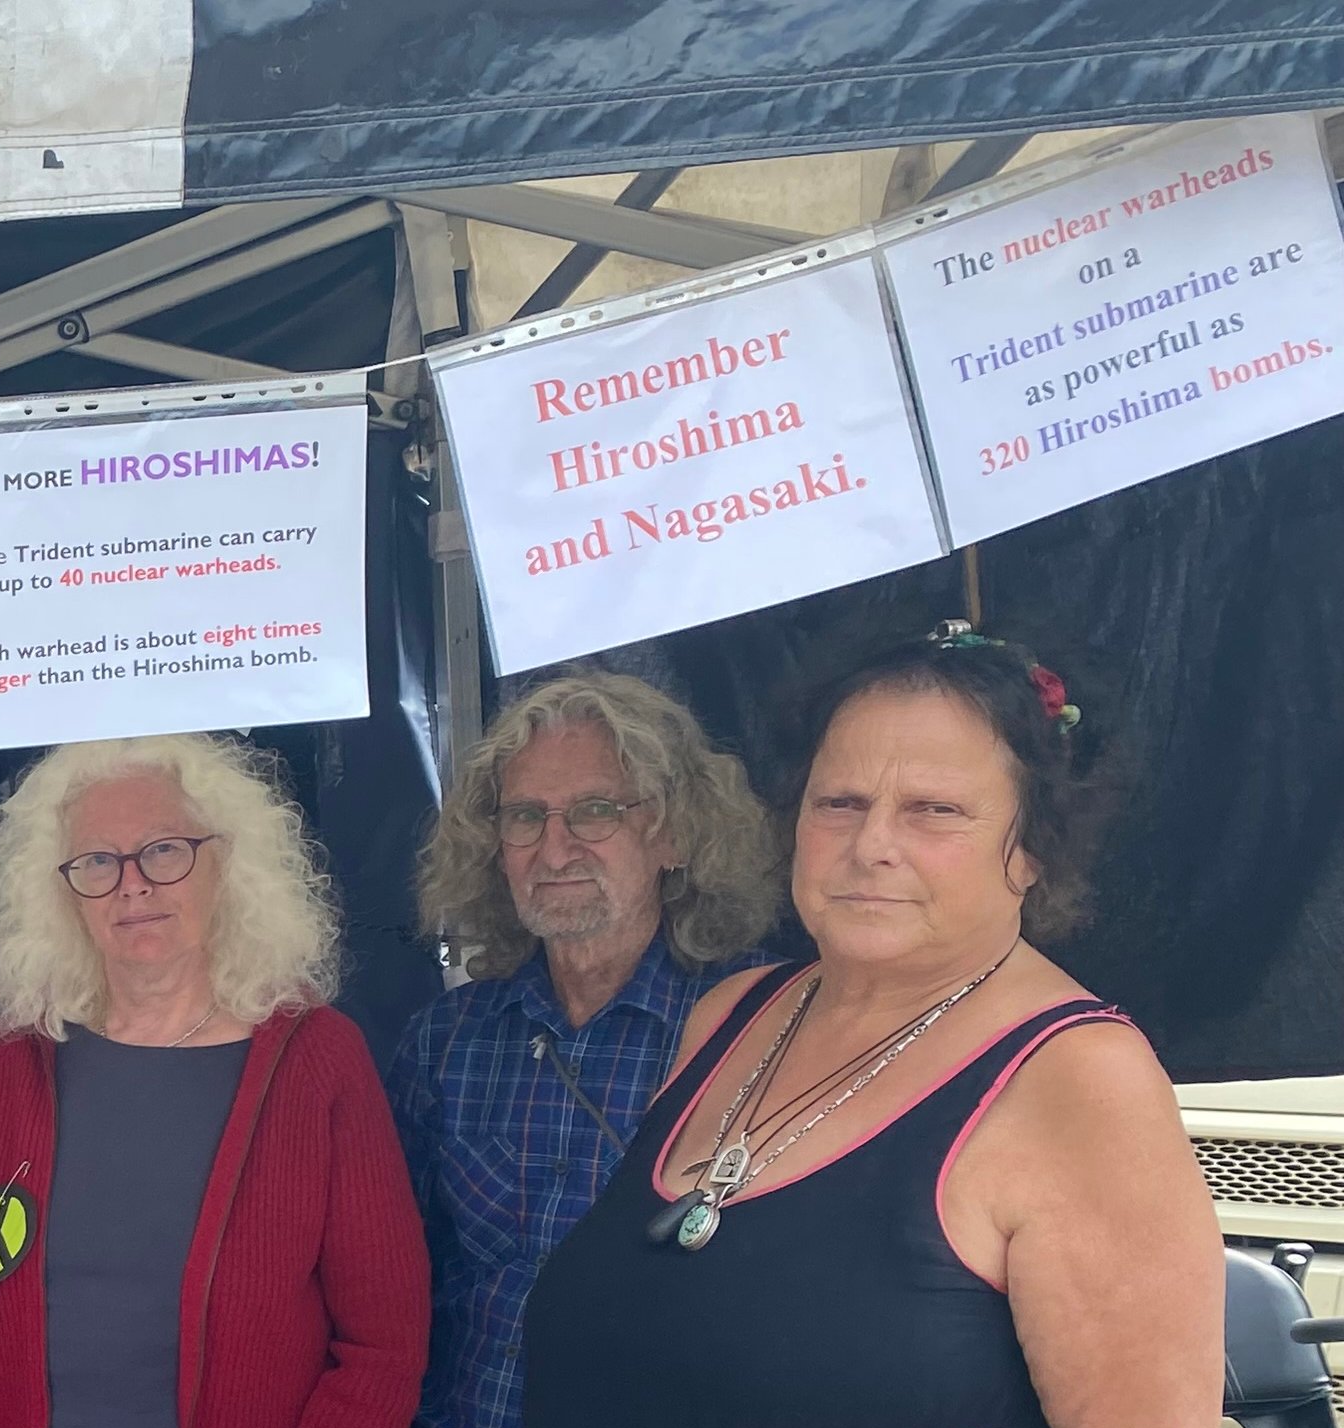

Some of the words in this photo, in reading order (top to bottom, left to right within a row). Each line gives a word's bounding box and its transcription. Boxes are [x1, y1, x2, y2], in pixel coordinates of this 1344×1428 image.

[933, 251, 995, 287] The
[1003, 207, 1112, 264] nuclear
[1121, 147, 1274, 218] warheads
[1078, 257, 1115, 285] on
[1124, 246, 1142, 267] a
[950, 323, 1066, 384] Trident
[1072, 264, 1240, 341] submarine
[1248, 242, 1304, 277] are
[529, 328, 790, 424] Remember
[1024, 380, 1056, 407] as
[1063, 319, 1203, 402] powerful
[1210, 312, 1245, 340] as
[545, 402, 806, 493] Hiroshima
[979, 435, 1030, 476] 320
[1036, 372, 1203, 455] Hiroshima
[1209, 337, 1334, 392] bombs.
[3, 468, 73, 492] MORE
[81, 439, 320, 486] HIROSHIMAS!
[13, 541, 95, 563] Trident
[100, 531, 212, 557] submarine
[219, 531, 255, 547] can
[262, 526, 318, 545] carry
[525, 518, 613, 576] and
[620, 453, 866, 552] Nagasaki.
[30, 574, 53, 590] to
[59, 568, 84, 587] 40
[91, 564, 170, 585] nuclear
[175, 553, 281, 578] warheads.
[17, 637, 106, 658] warhead
[114, 635, 129, 651] is
[135, 630, 198, 650] about
[203, 623, 257, 648] eight
[262, 620, 322, 639] times
[37, 666, 84, 685] than
[91, 662, 126, 681] the
[133, 654, 245, 677] Hiroshima
[250, 645, 318, 667] bomb.
